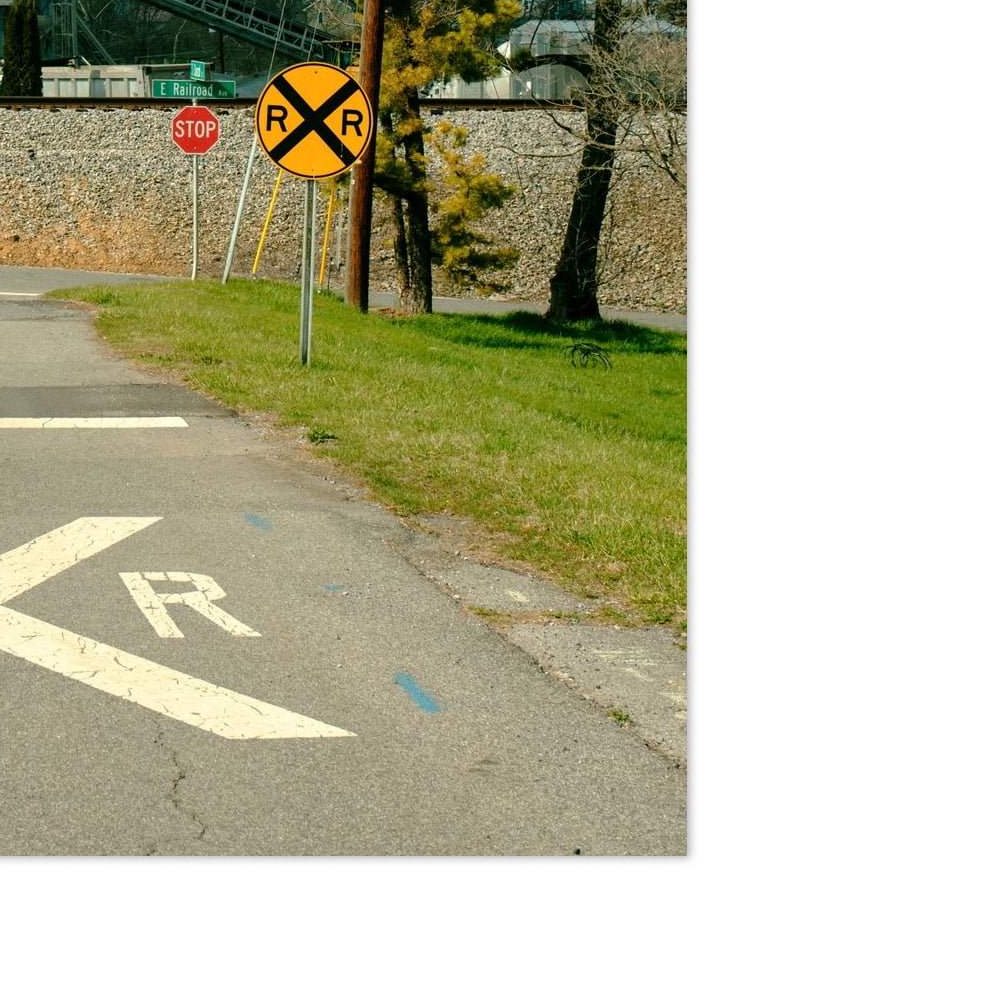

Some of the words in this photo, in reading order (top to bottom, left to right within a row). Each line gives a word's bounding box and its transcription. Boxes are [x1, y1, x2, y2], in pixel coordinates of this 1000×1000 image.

[160, 82, 167, 96] E
[173, 82, 213, 96] Railroad
[174, 120, 217, 138] STOP
[266, 104, 288, 132] R
[341, 109, 364, 136] R
[118, 571, 262, 638] R
